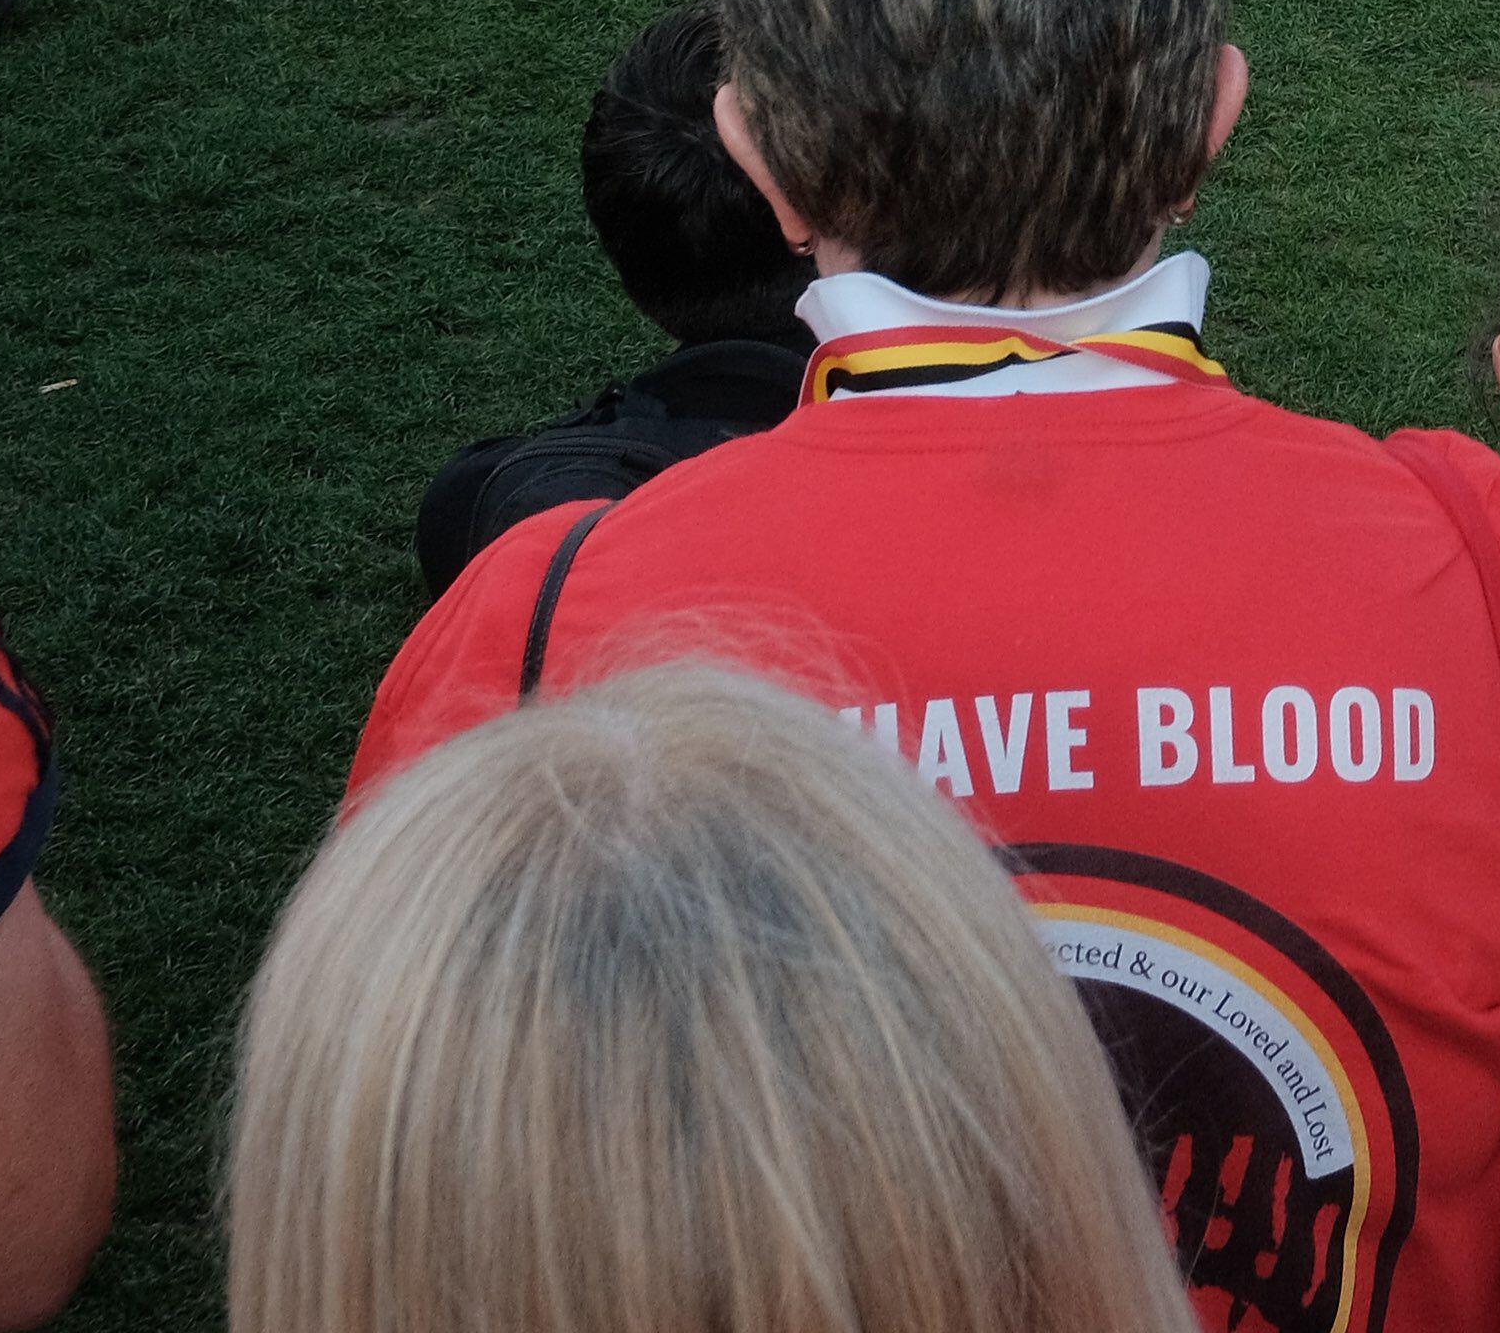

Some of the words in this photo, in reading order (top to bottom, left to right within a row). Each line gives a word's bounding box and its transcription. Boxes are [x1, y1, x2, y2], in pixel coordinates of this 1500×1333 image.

[1135, 684, 1437, 789] BLOOD
[1043, 939, 1122, 973] ected
[1129, 949, 1156, 979] &
[1160, 967, 1214, 1006] our
[1211, 992, 1291, 1067] Loved
[1278, 1057, 1316, 1104] and
[1302, 1098, 1335, 1161] Lost
